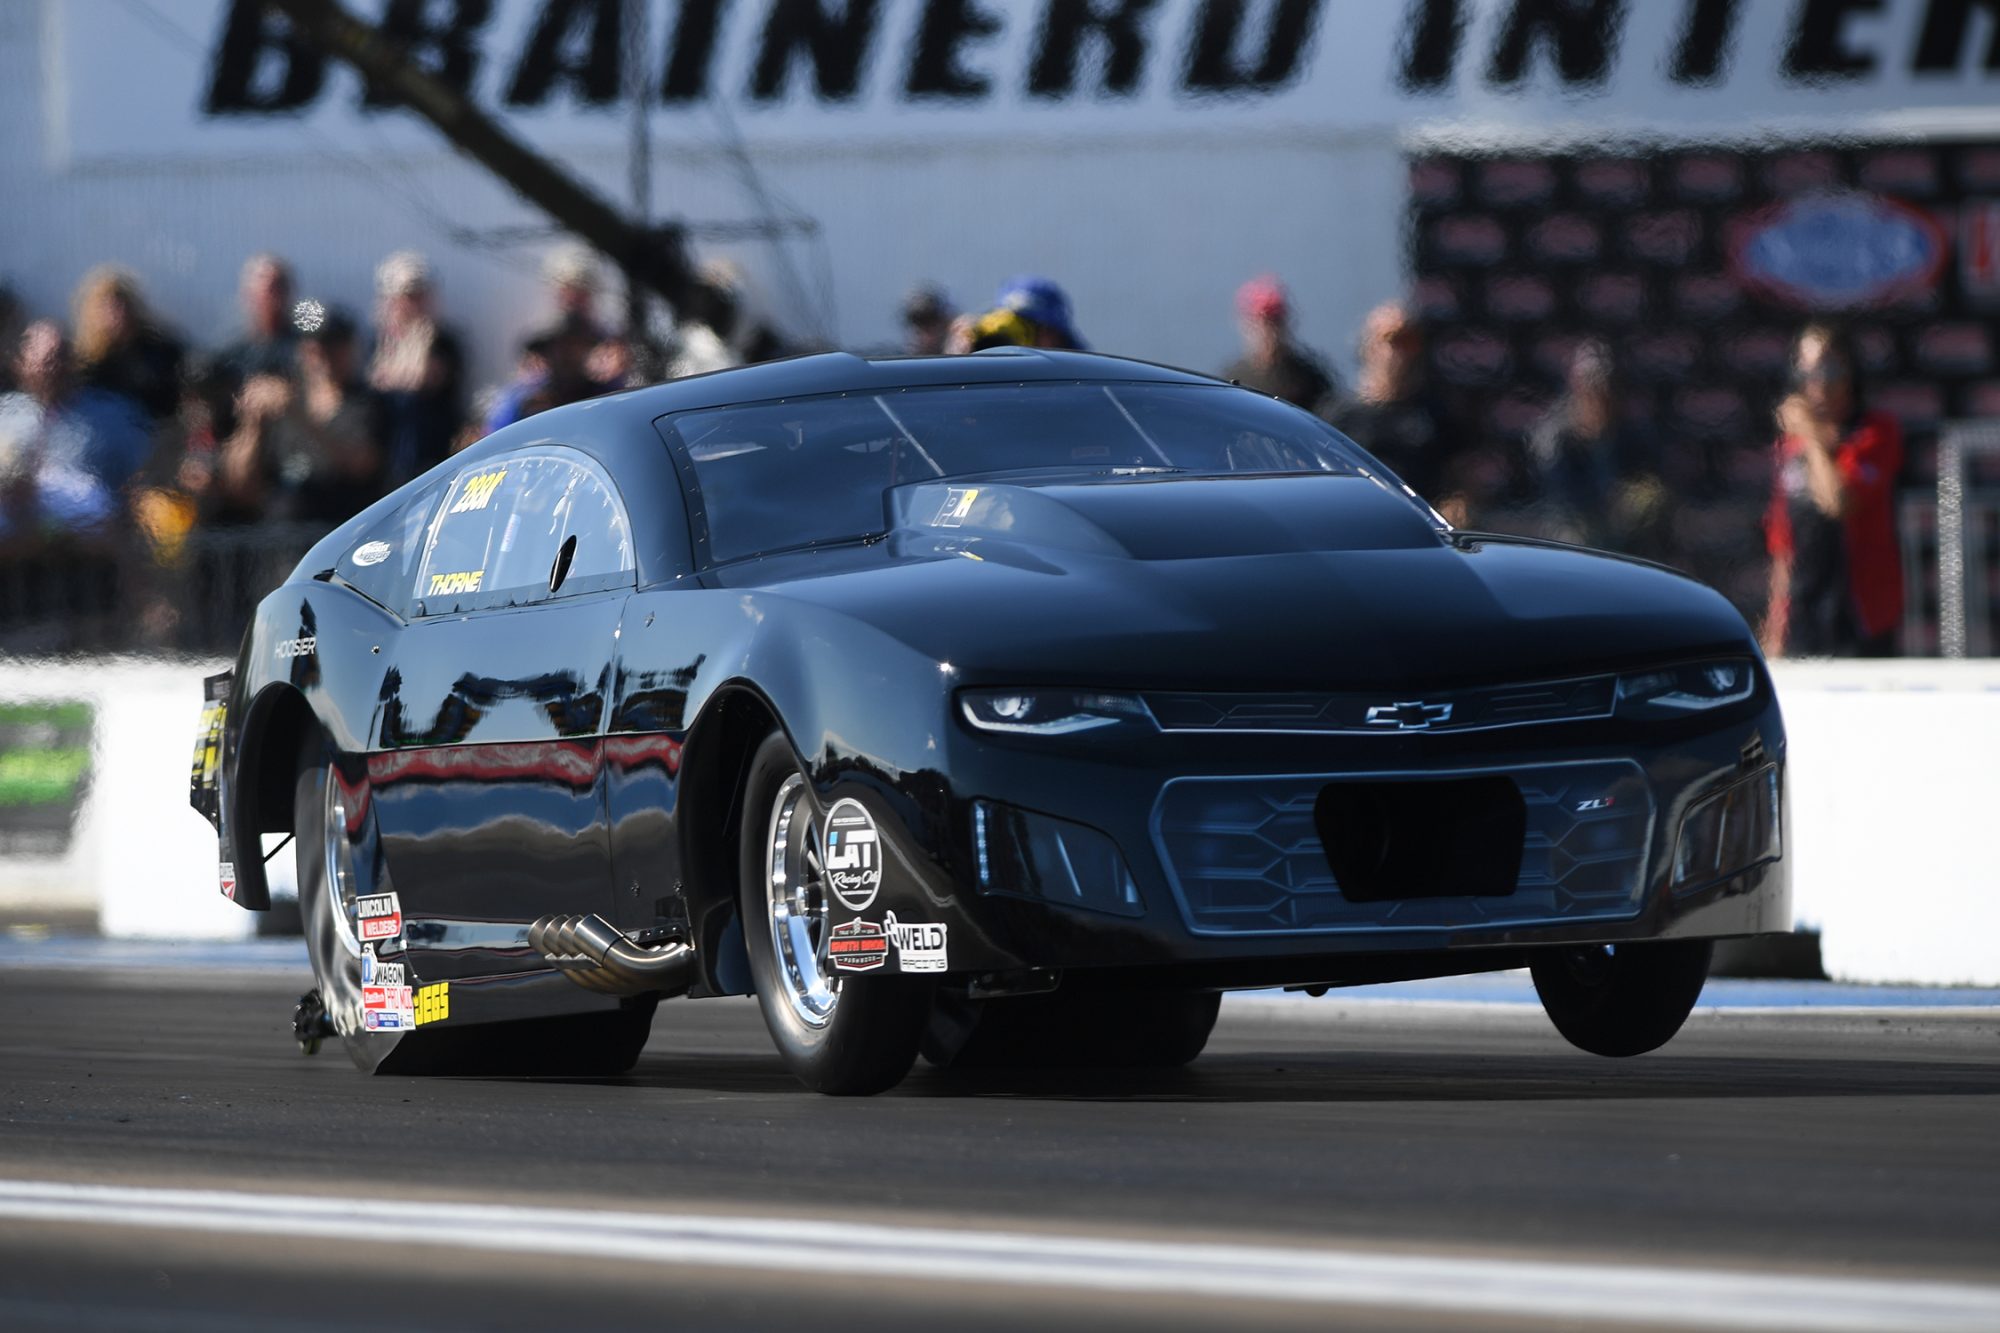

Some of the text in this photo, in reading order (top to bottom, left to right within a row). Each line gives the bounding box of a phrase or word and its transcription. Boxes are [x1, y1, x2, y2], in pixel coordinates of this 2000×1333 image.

[428, 570, 484, 596] THORNE
[274, 637, 316, 658] HOOSIER
[828, 830, 877, 869] LAT
[357, 896, 392, 917] LINCOLN
[365, 919, 397, 936] WELDERS
[898, 927, 944, 950] WELD
[376, 964, 403, 984] WAGON
[413, 982, 449, 1025] JEGS
